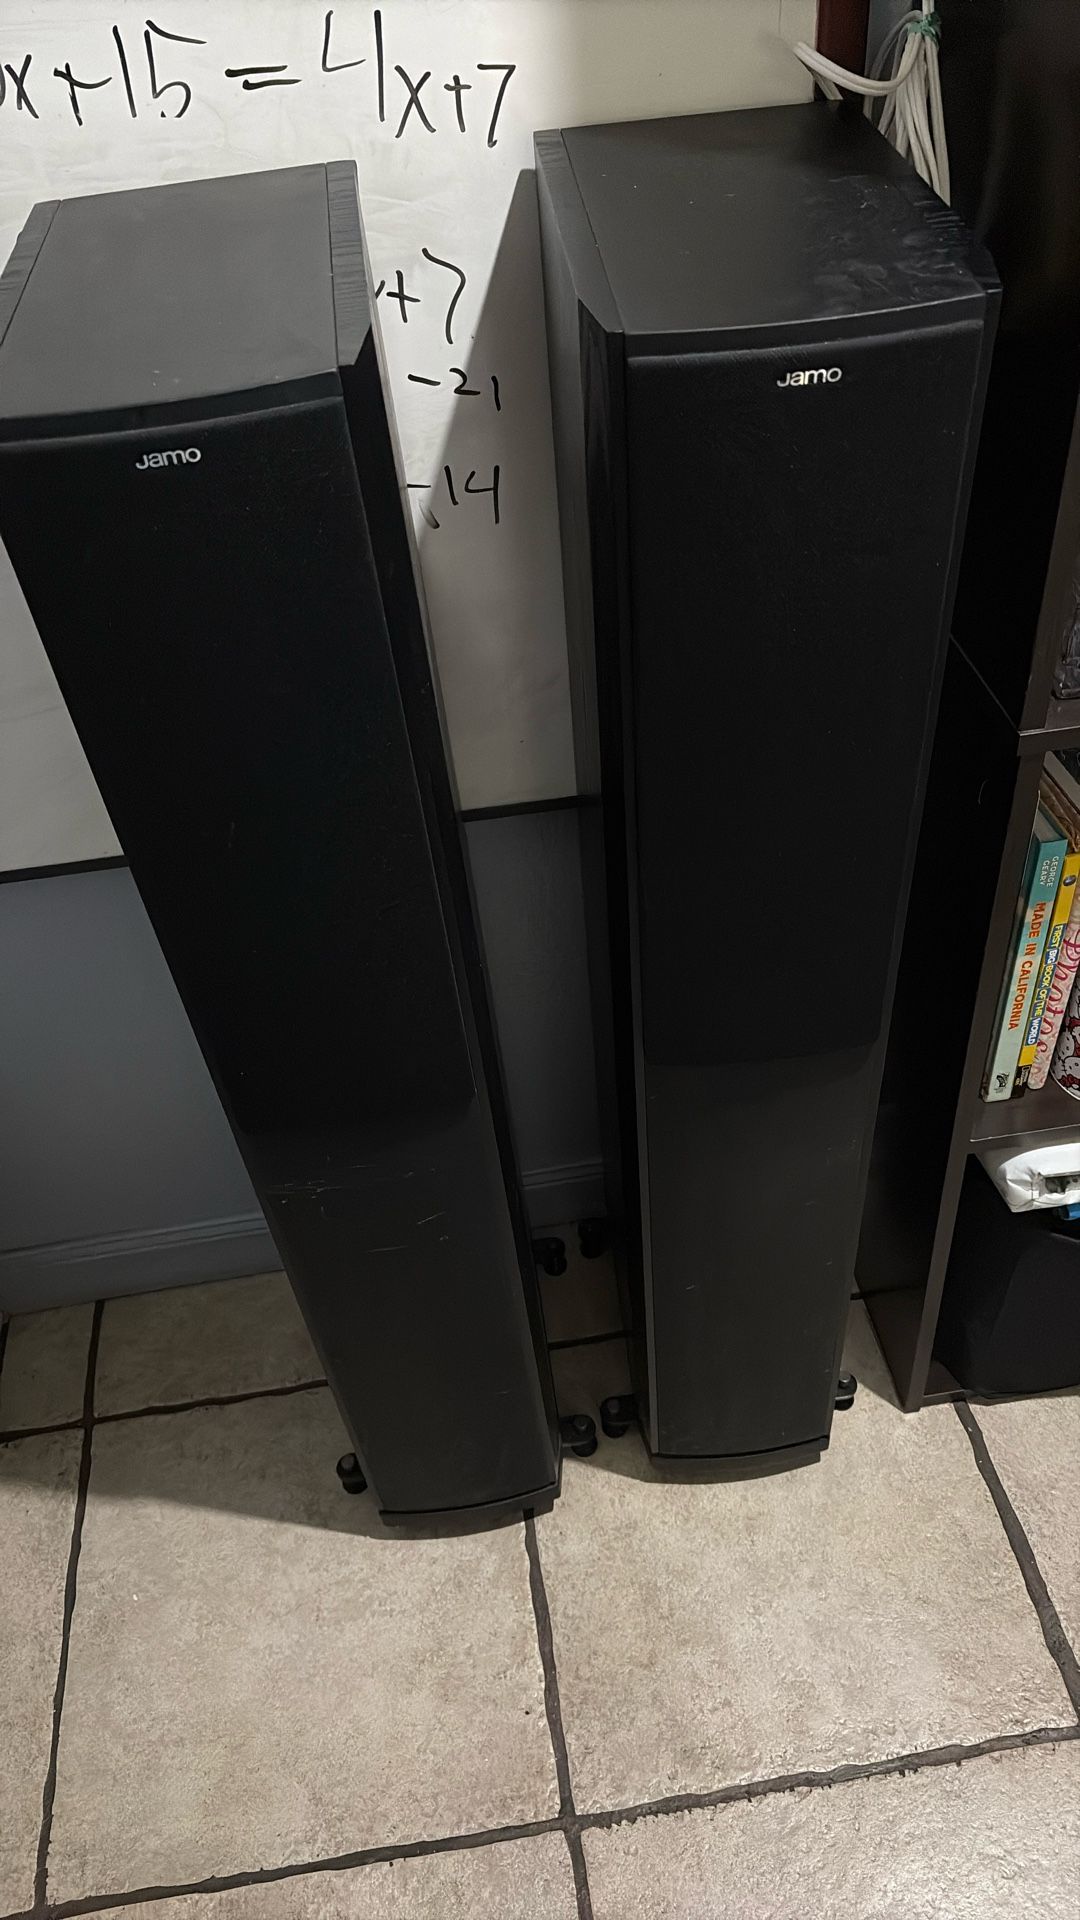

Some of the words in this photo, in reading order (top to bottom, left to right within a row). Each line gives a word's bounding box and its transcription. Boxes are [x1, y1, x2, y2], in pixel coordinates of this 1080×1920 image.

[776, 367, 843, 388] Jamo
[135, 447, 202, 470] Jamo
[1039, 859, 1050, 886] GEARY
[1046, 855, 1060, 888] GEORGE
[1028, 902, 1047, 939] MADE
[1051, 924, 1064, 948] FIRST
[1023, 942, 1038, 956] IN
[1047, 948, 1058, 964] BIG
[1041, 964, 1054, 988] BOOK
[1007, 960, 1034, 1031] CALIFORNIA
[1038, 988, 1048, 1001] OF
[1033, 1001, 1045, 1017] THE
[1027, 1017, 1041, 1045] WORLD
